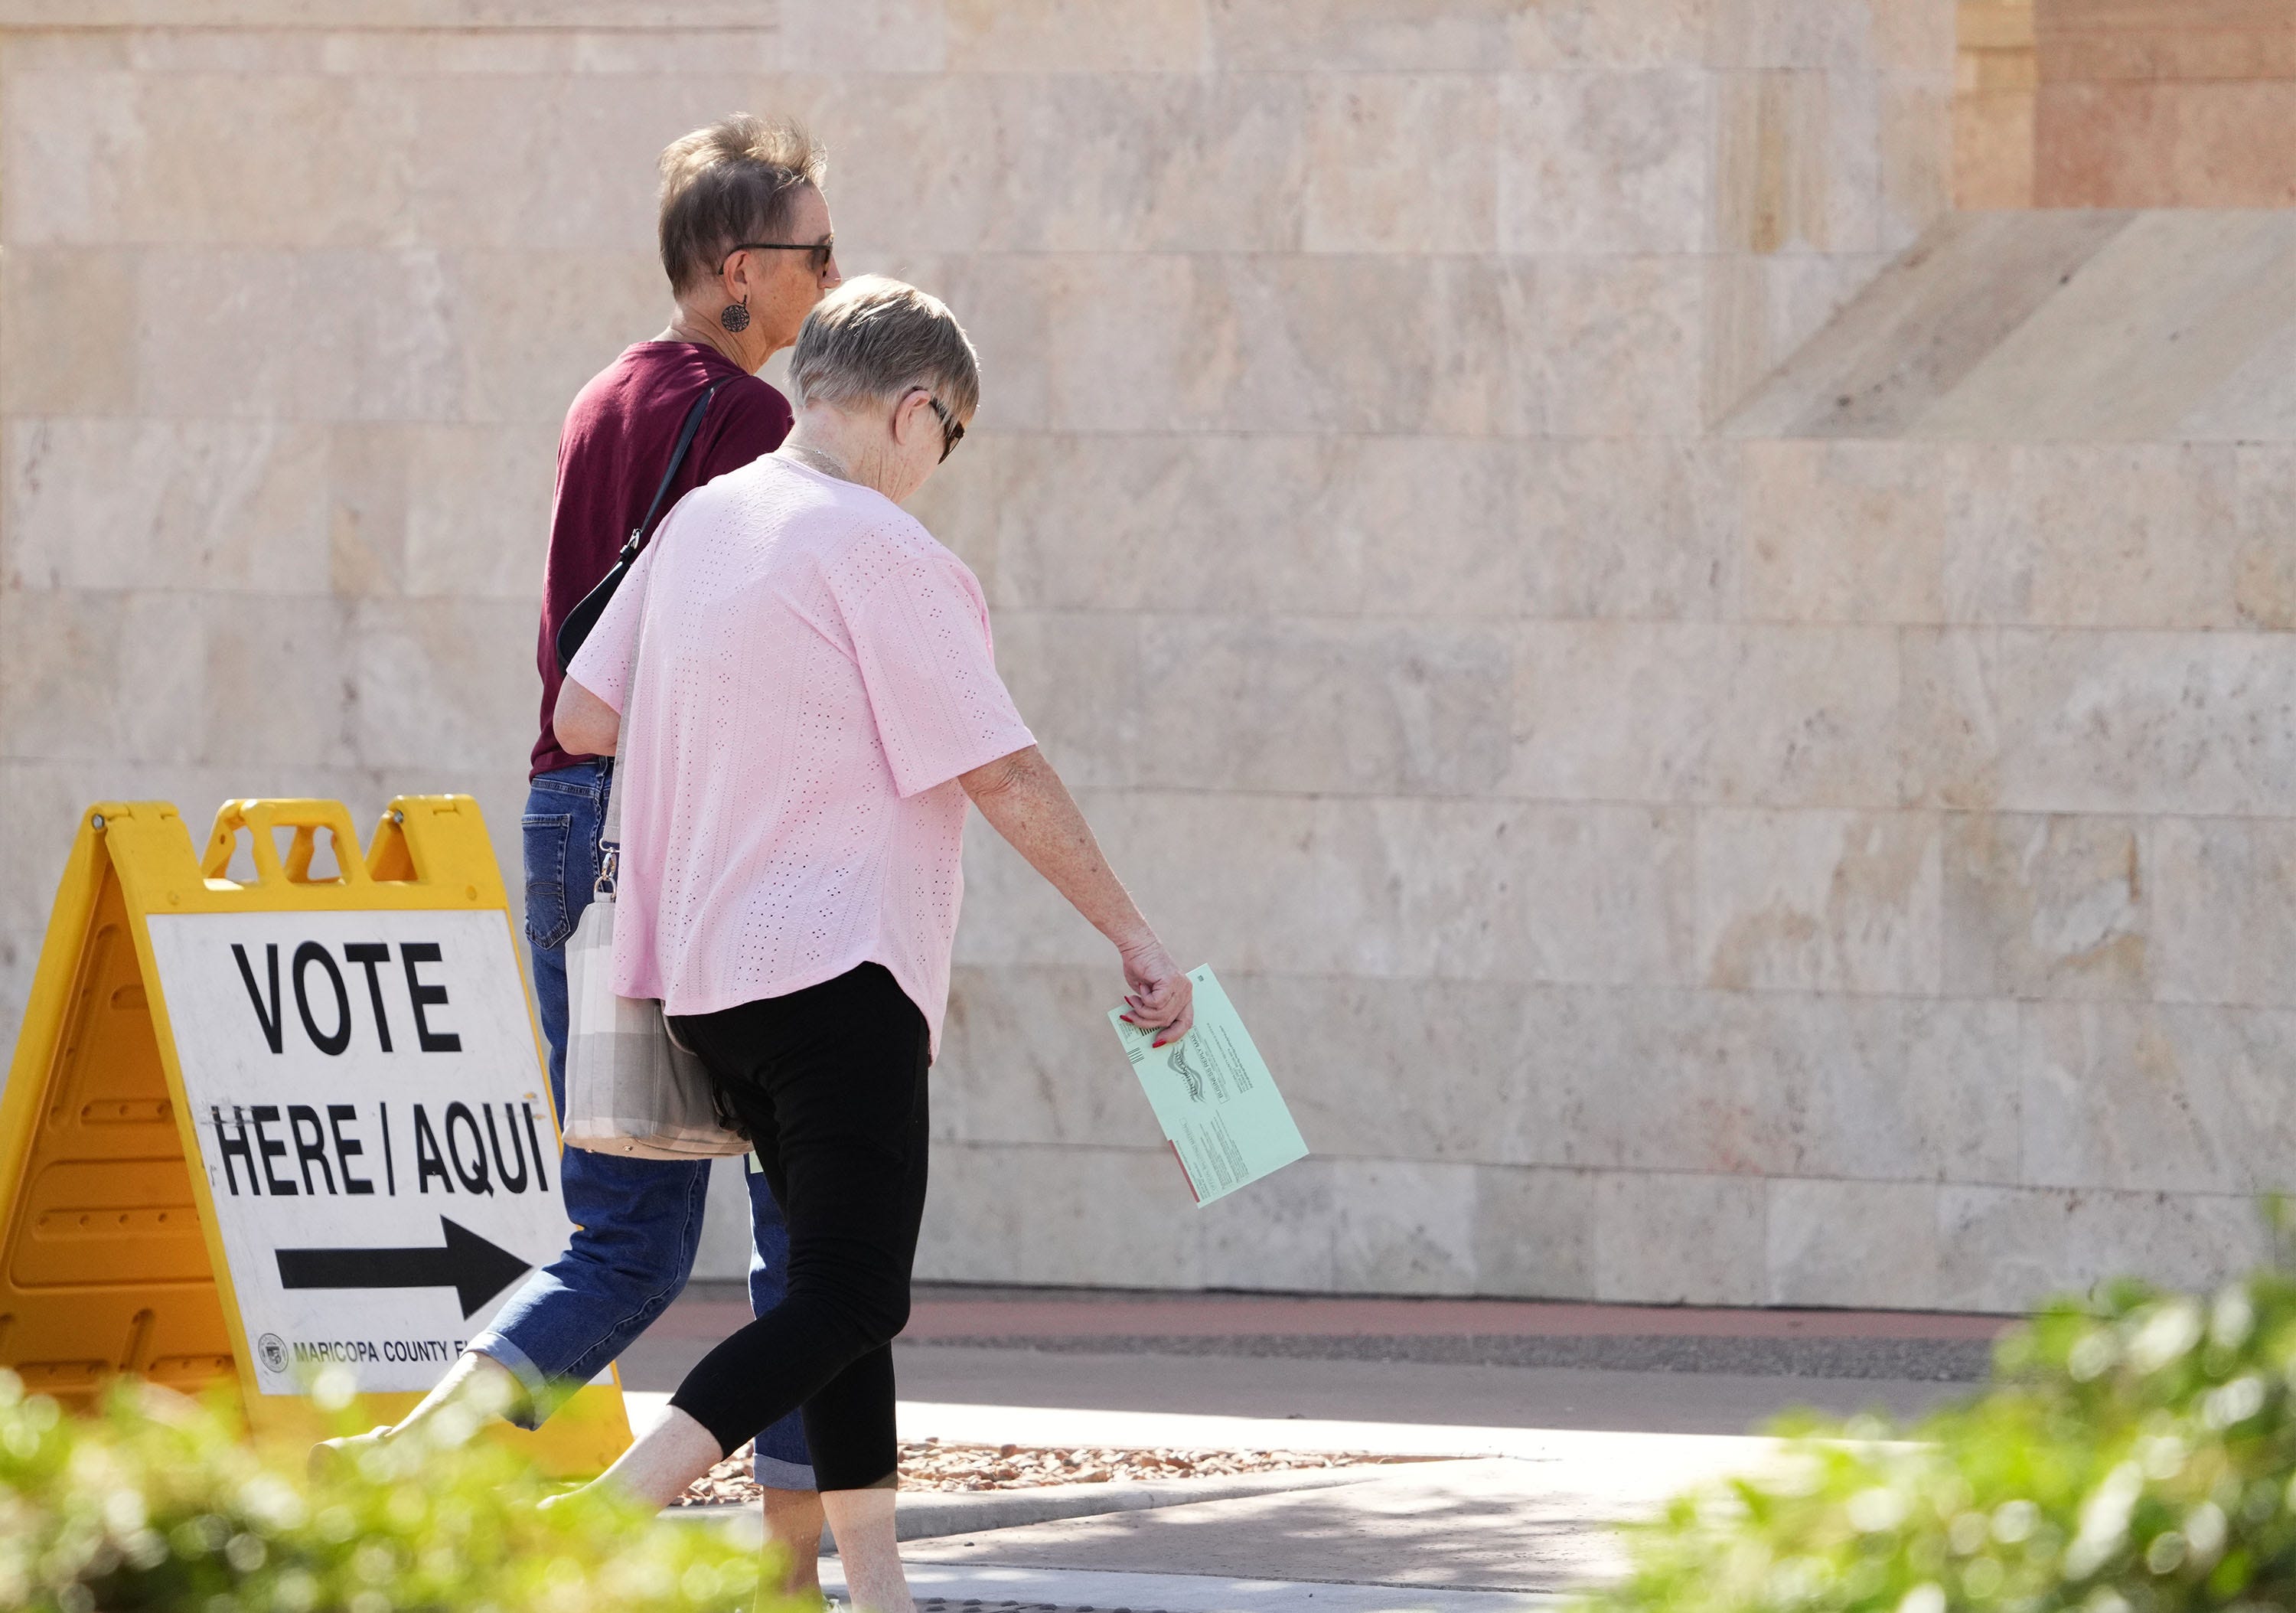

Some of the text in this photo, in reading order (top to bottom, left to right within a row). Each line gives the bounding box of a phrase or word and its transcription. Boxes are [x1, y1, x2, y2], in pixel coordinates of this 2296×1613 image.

[231, 941, 462, 1056] VOTE
[212, 1105, 373, 1197] HERE
[413, 1102, 549, 1198] AQUI
[293, 1341, 380, 1363] MARICOPA
[383, 1340, 448, 1362] COUNTY
